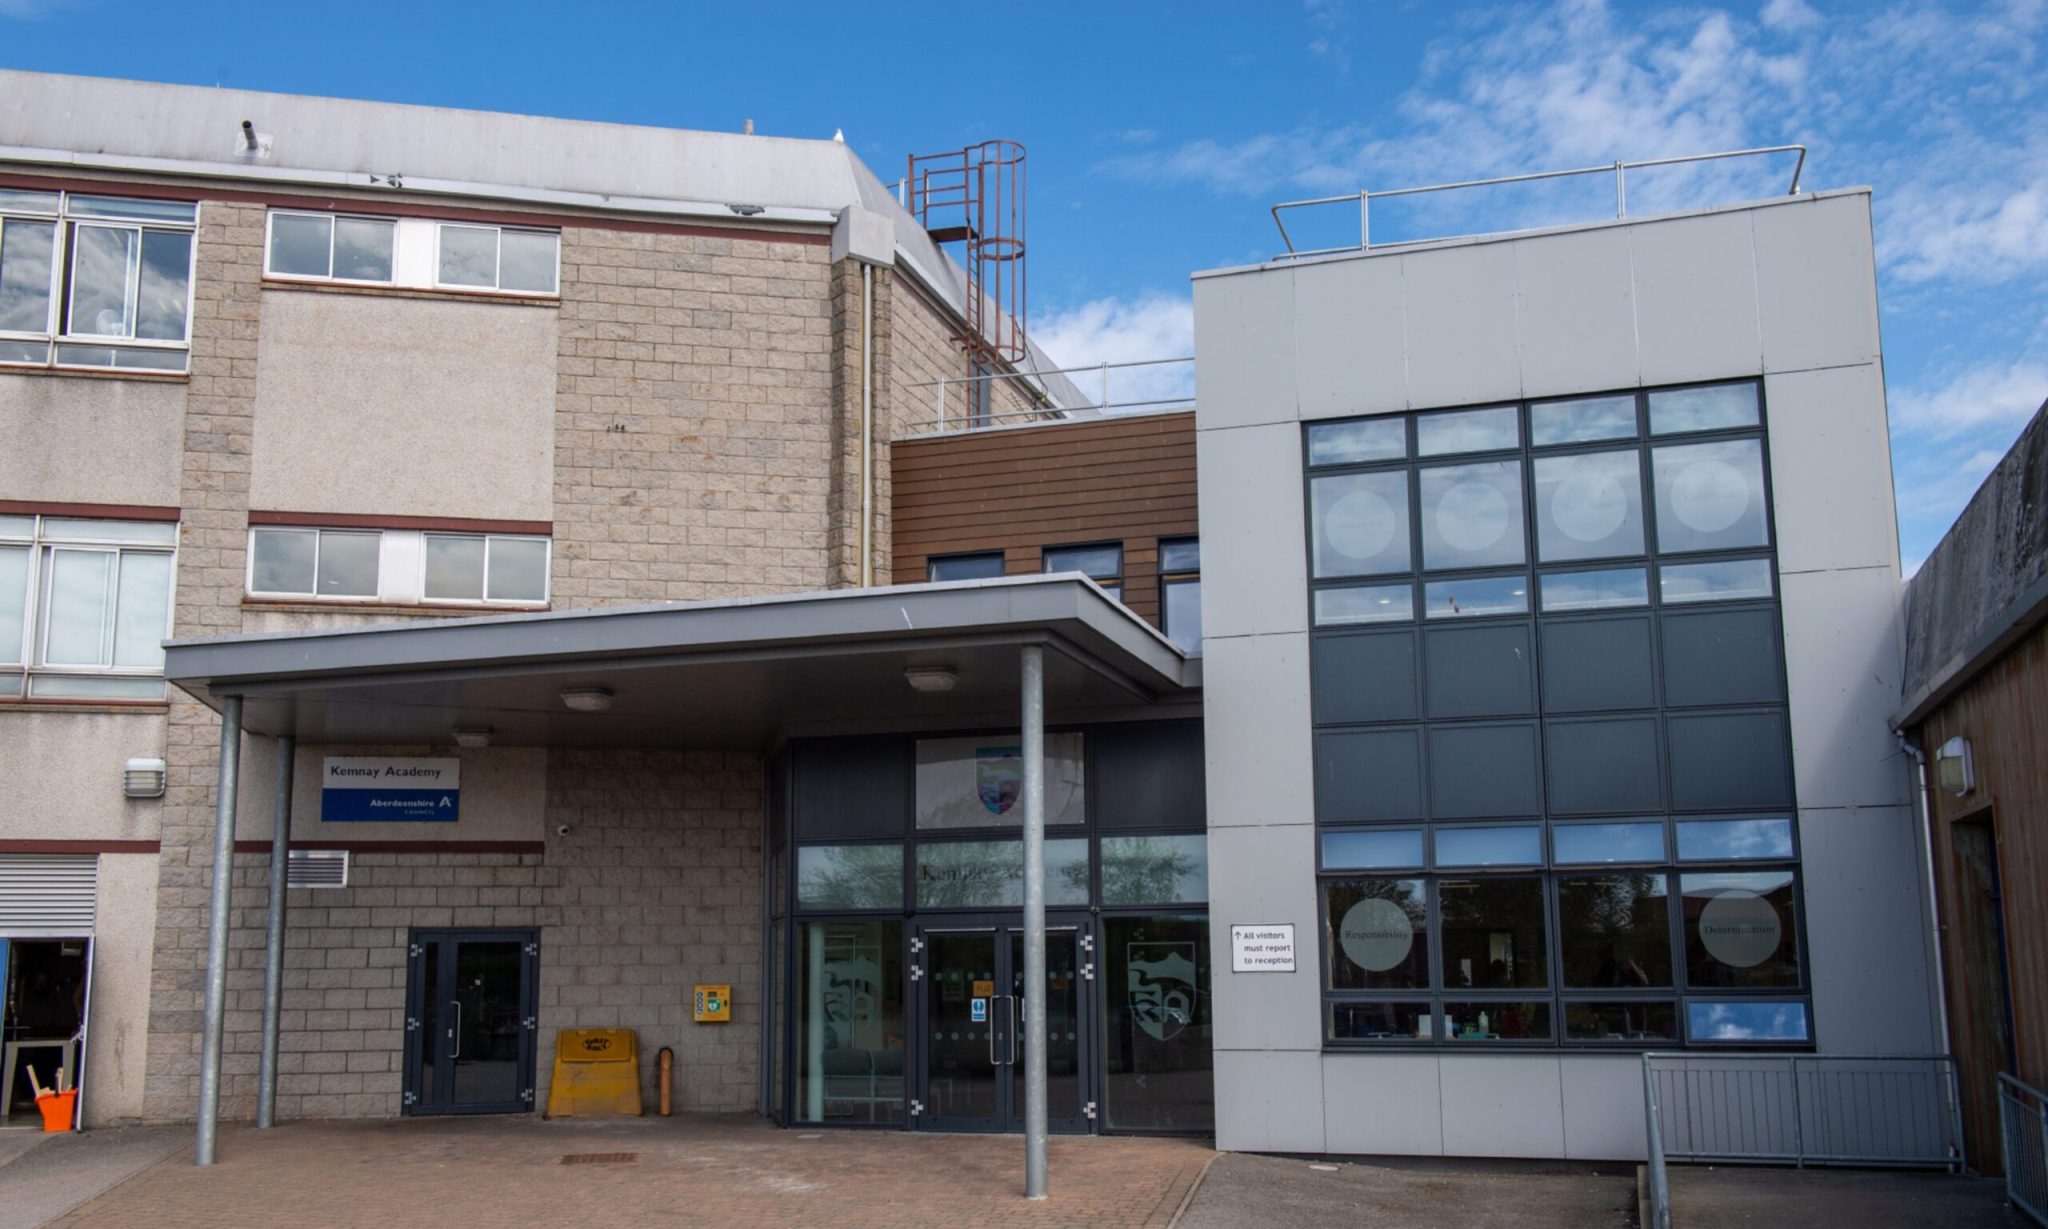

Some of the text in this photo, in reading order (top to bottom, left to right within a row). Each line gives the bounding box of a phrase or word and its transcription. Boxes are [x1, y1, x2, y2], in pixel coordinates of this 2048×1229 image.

[330, 766, 442, 779] Kemnay Academy
[369, 798, 435, 808] Aberdeenshire
[1344, 929, 1408, 941] Responsibility
[1704, 925, 1776, 935] Determination
[1243, 931, 1285, 940] All visitors
[1265, 945, 1291, 953] report
[1244, 957, 1294, 966] to reception
